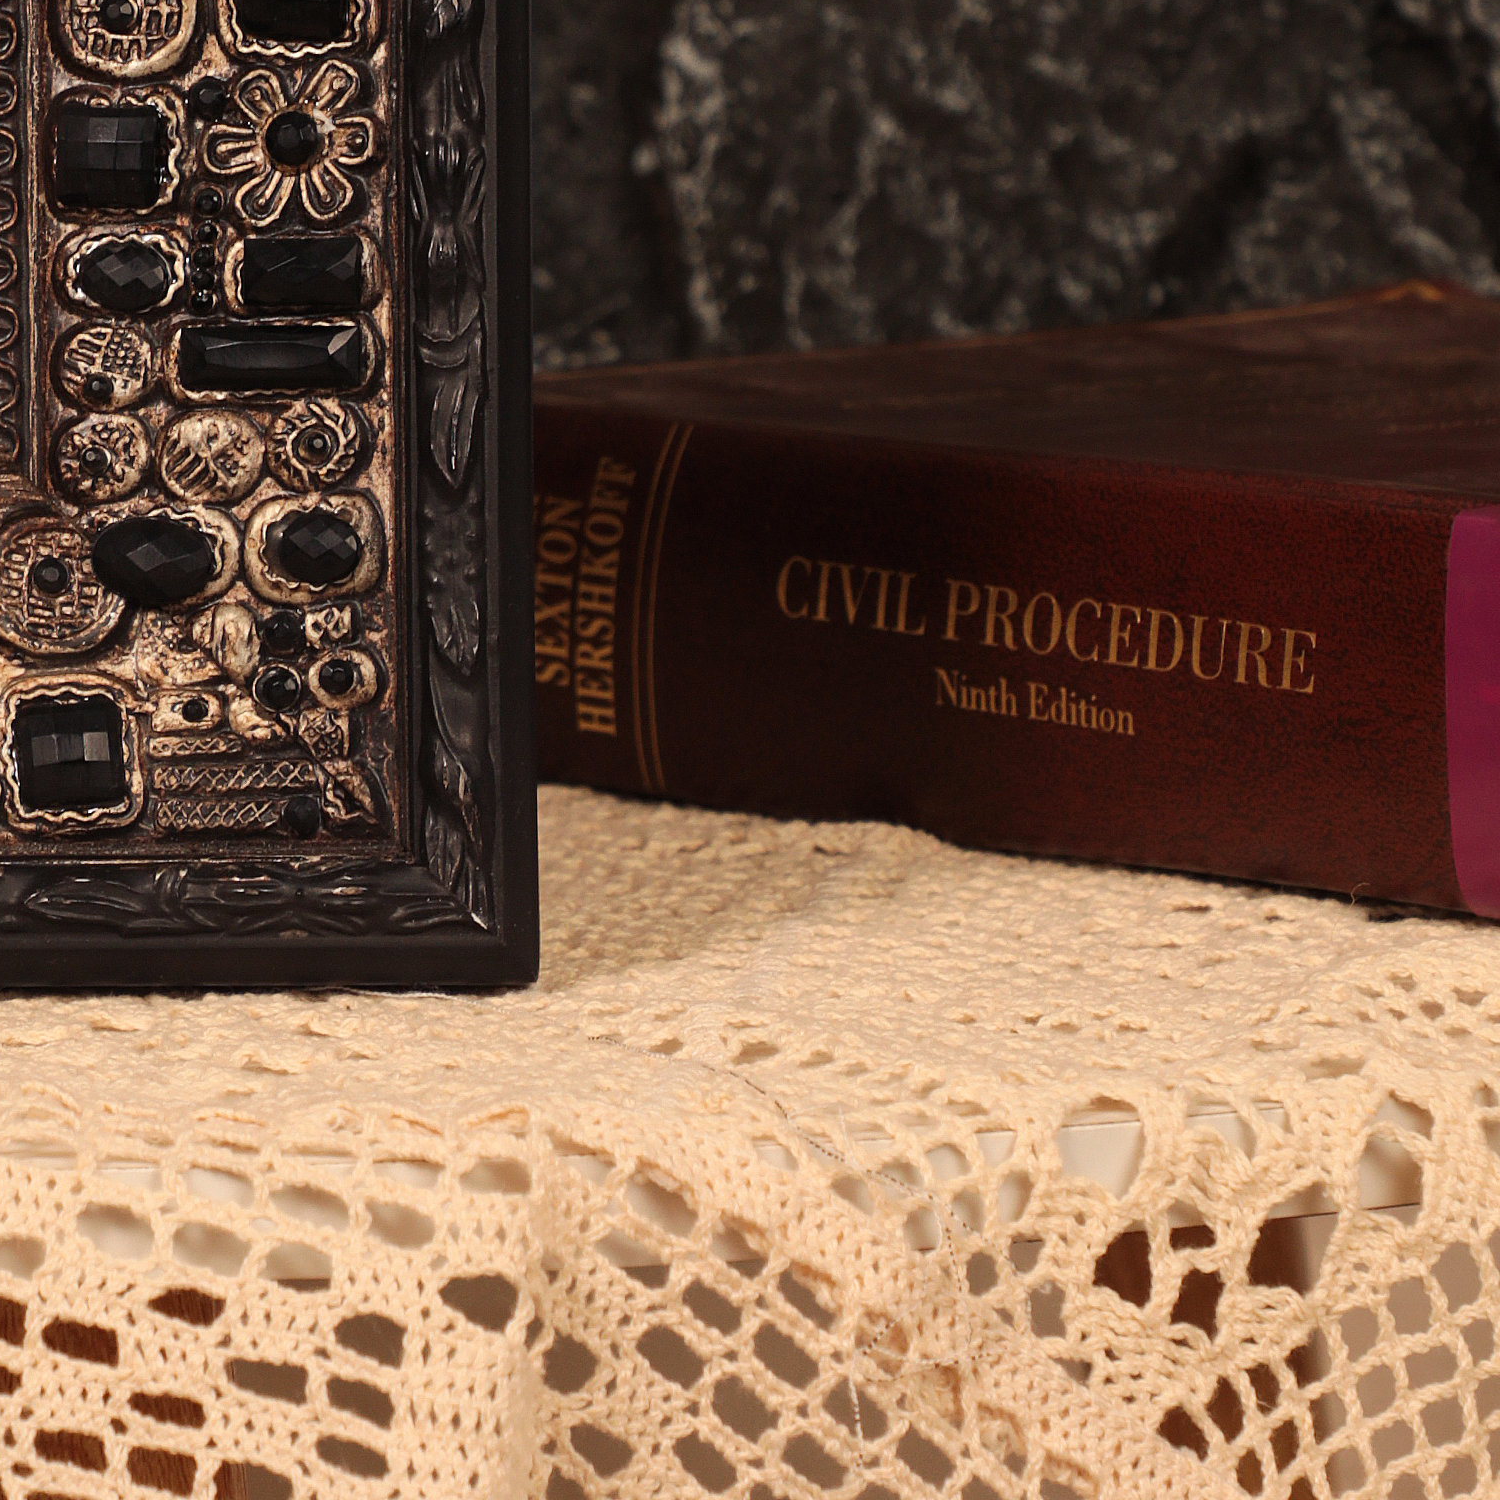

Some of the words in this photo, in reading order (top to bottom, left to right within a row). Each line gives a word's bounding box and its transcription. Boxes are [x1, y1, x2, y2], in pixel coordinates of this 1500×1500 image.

[534, 496, 583, 687] SEXTON
[574, 455, 636, 737] HERSHKOFF
[776, 555, 927, 636] CIVIL
[940, 577, 1317, 695] PROCEDURE
[934, 667, 1019, 718] Ninth
[1027, 680, 1136, 736] Edition
